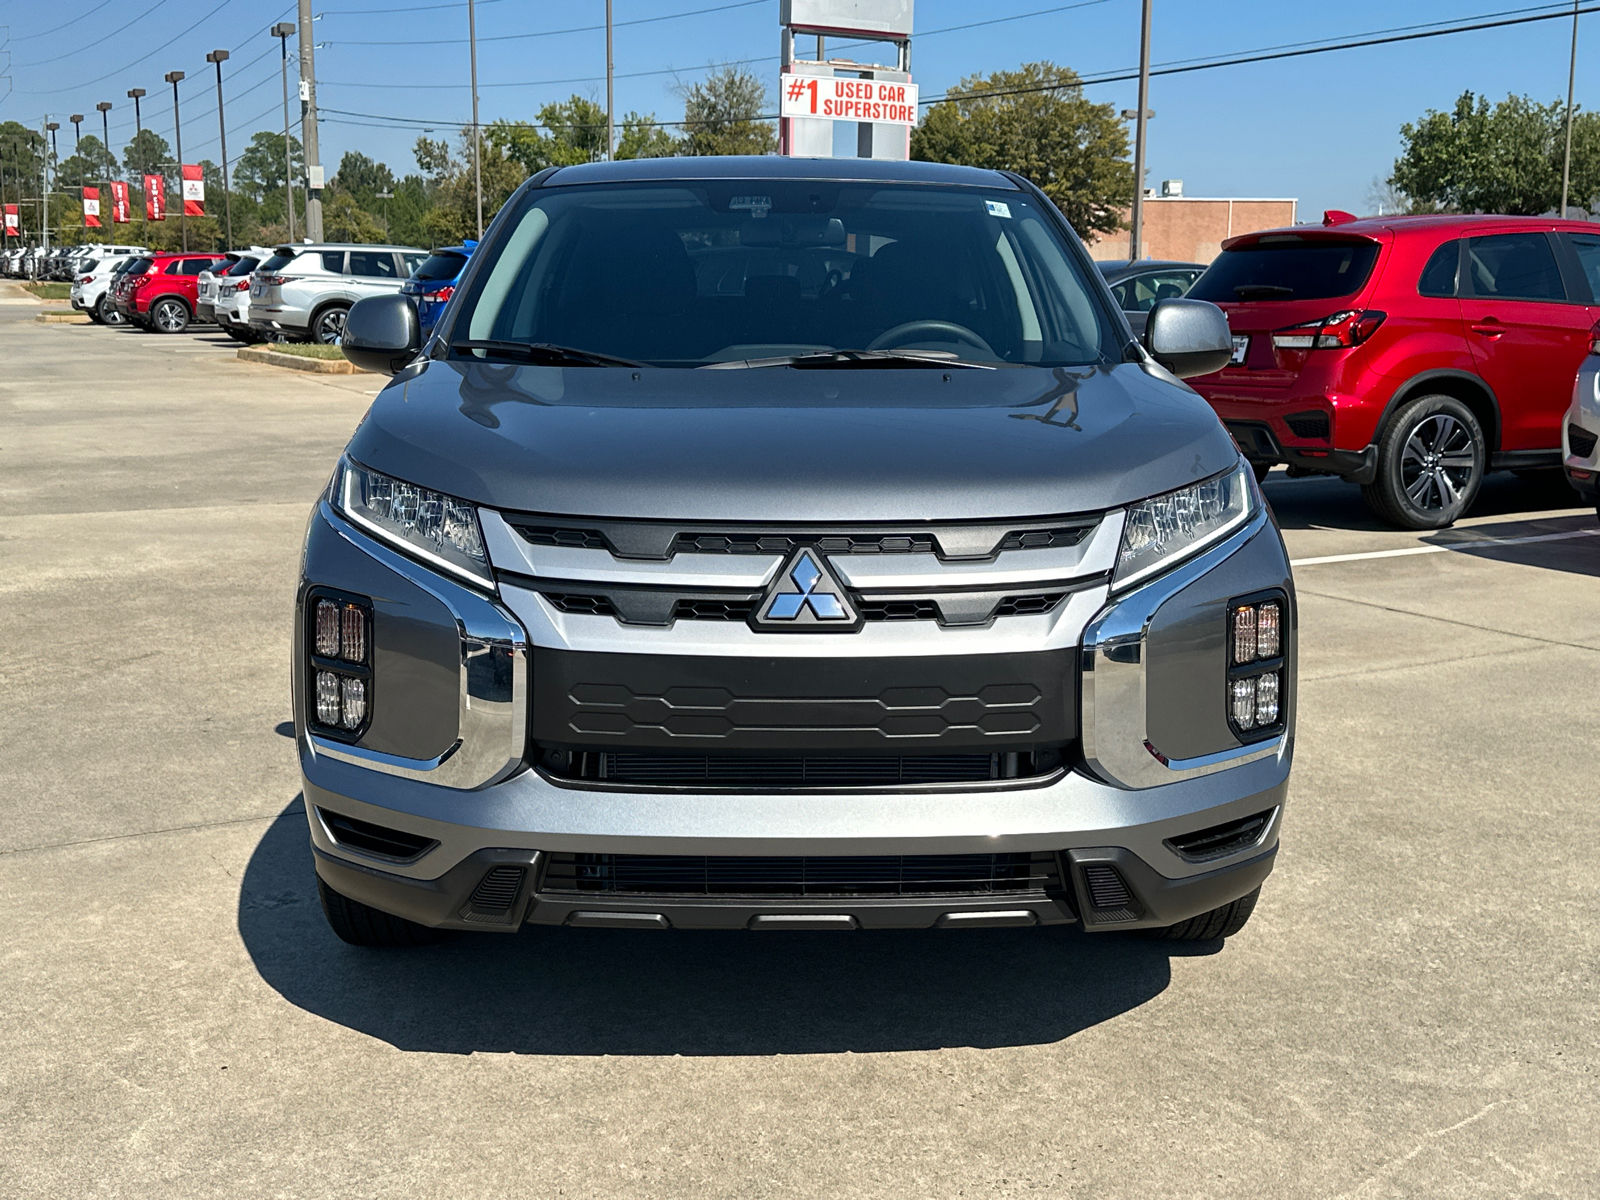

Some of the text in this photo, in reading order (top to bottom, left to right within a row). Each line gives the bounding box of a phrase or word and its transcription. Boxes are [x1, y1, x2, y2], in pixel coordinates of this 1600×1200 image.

[787, 79, 818, 114] #1
[835, 81, 906, 103] USED CAR
[823, 98, 915, 122] SUPERSTORE
